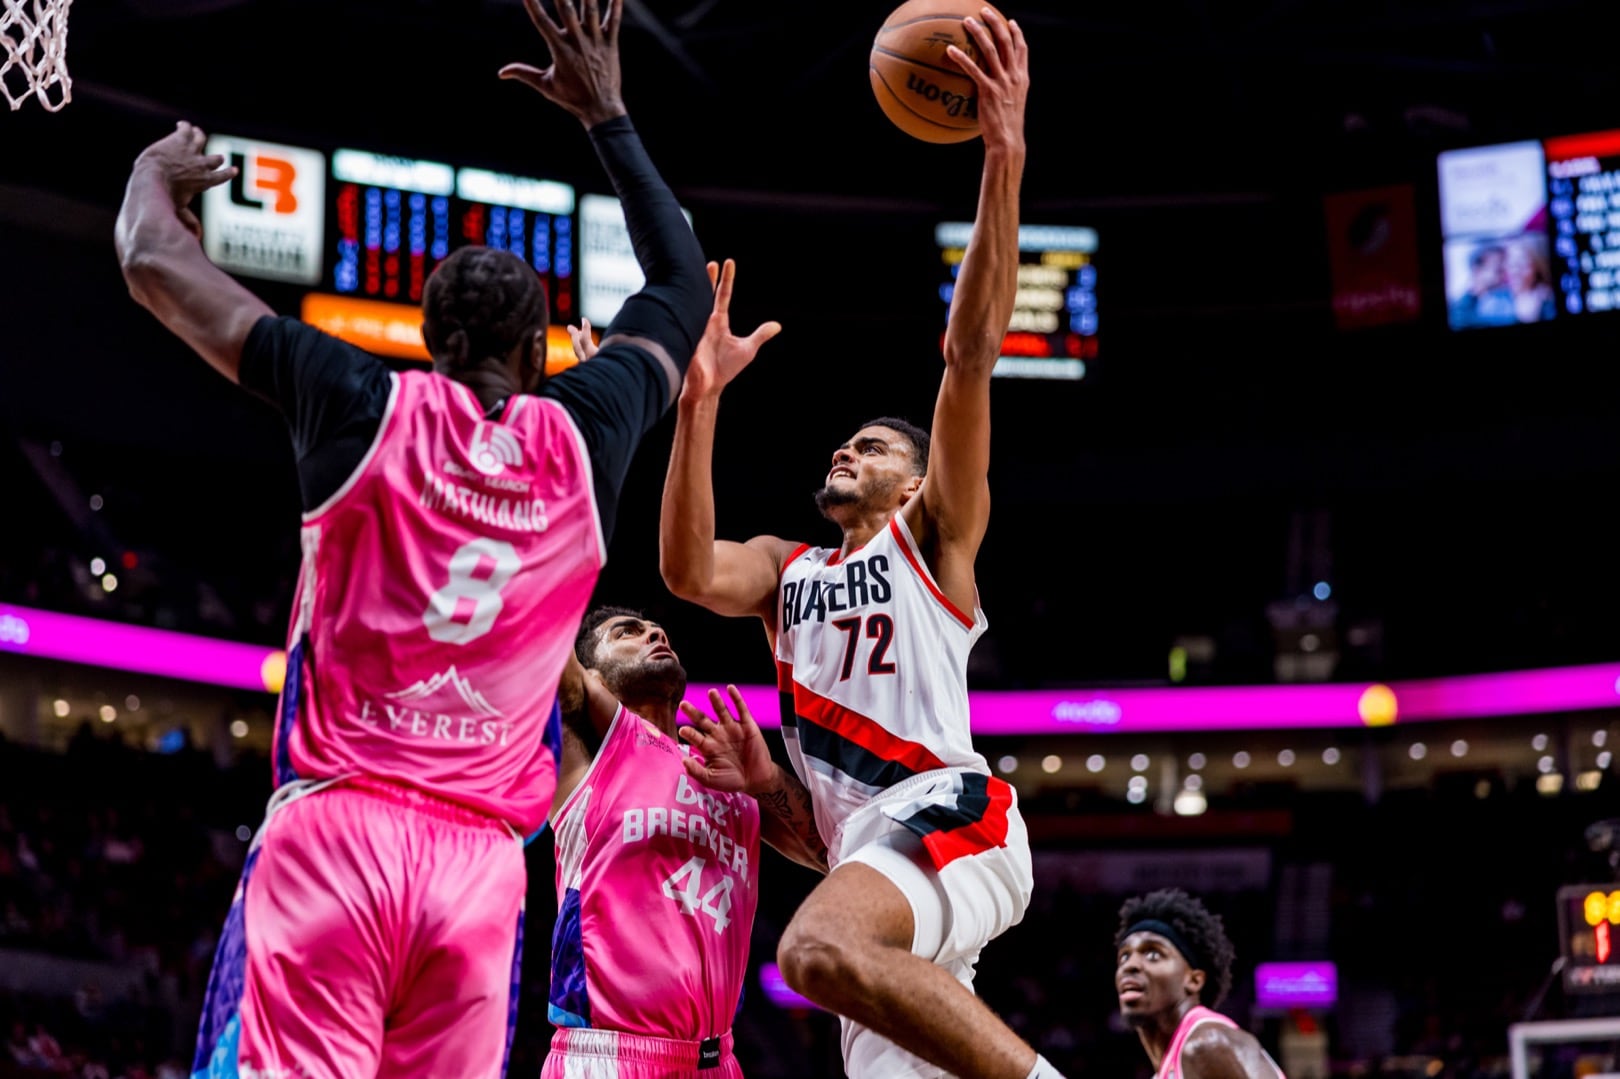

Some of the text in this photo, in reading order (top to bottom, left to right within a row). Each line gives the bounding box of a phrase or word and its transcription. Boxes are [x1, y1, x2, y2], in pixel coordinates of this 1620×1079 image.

[907, 73, 977, 119] ilson
[418, 471, 549, 533] MATHIANG
[421, 537, 522, 645] 8
[831, 612, 896, 682] 72
[360, 700, 514, 747] EVEREST
[676, 774, 730, 827] bnz
[622, 807, 751, 889] BREAKER
[662, 855, 734, 936] 44
